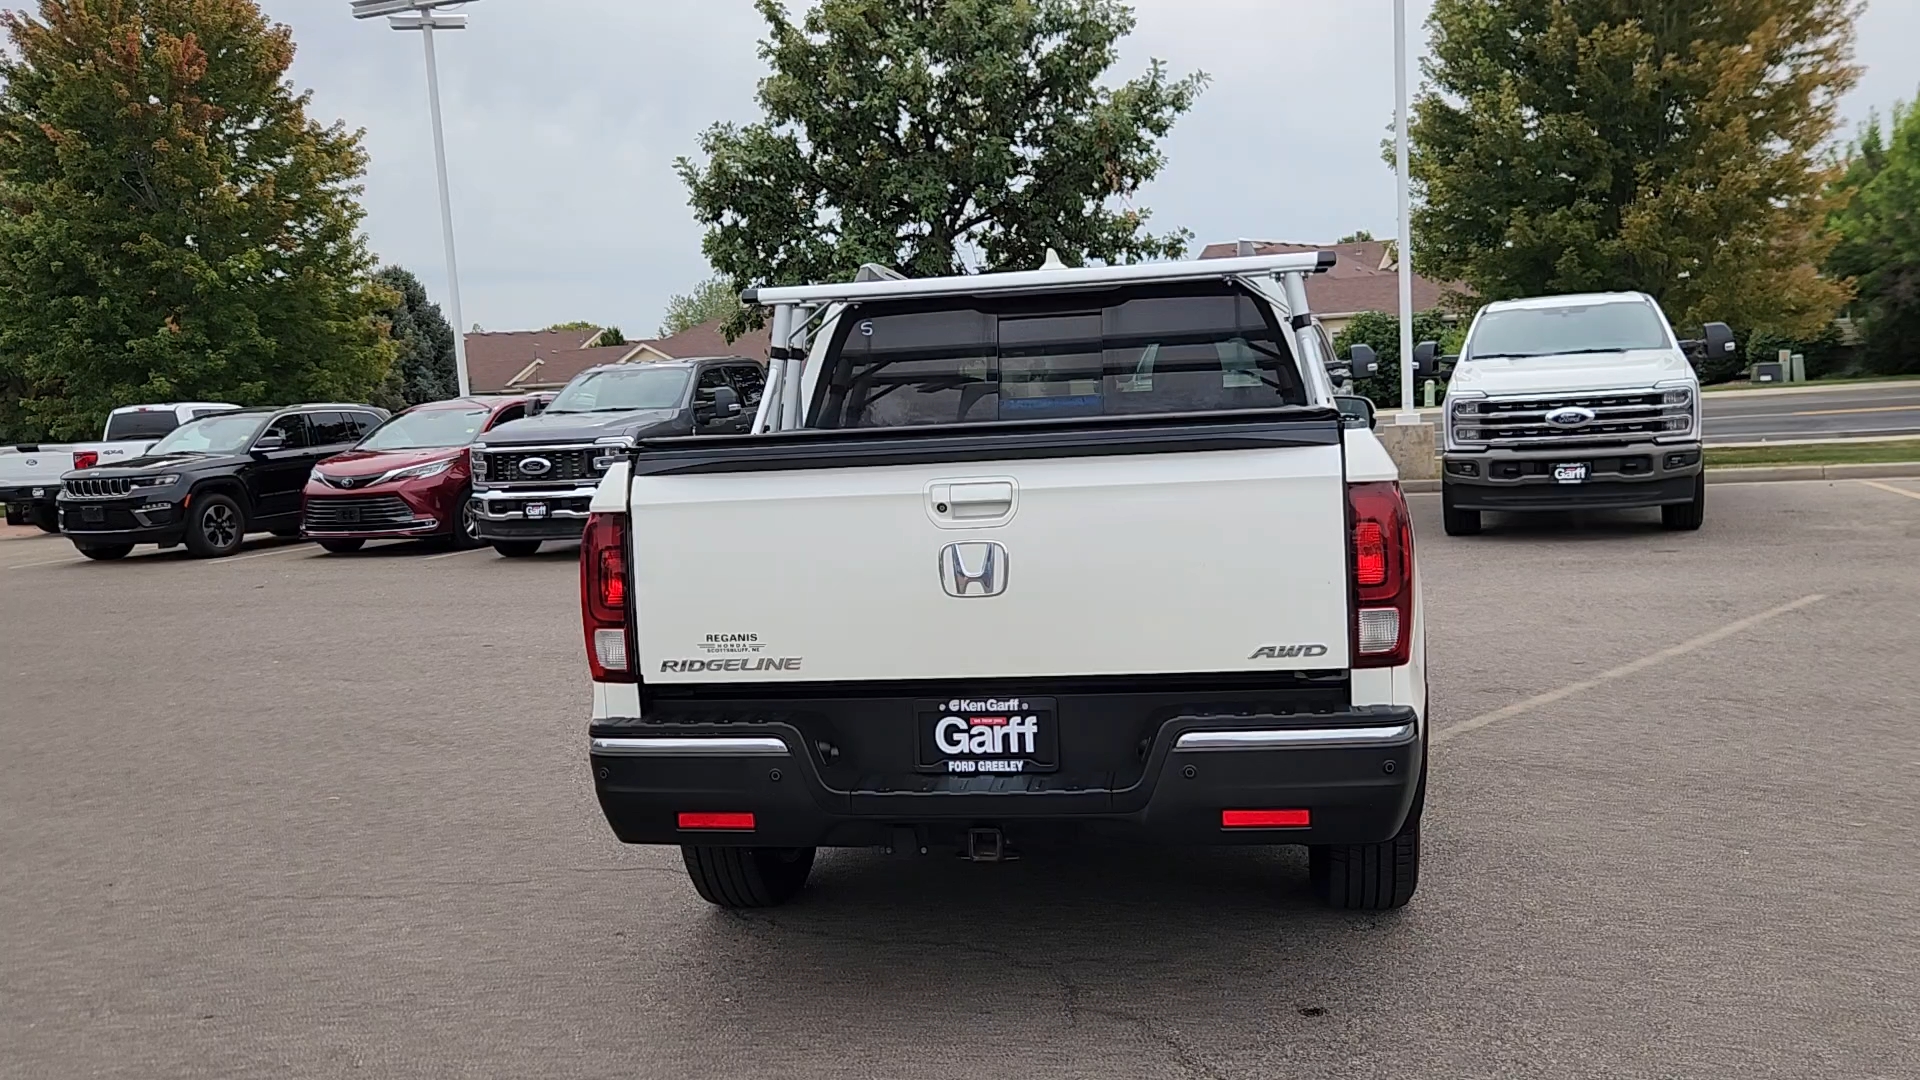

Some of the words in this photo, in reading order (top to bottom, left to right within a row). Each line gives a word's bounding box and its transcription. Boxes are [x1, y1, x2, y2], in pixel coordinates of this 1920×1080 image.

[1558, 411, 1581, 422] Ford
[1554, 466, 1586, 480] Garff
[525, 505, 546, 516] Garff
[706, 633, 758, 642] REGANIS
[1248, 644, 1328, 659] AWD
[660, 657, 803, 673] RIDGELINE
[935, 716, 1038, 754] Garff
[948, 761, 975, 772] FORD
[977, 760, 1024, 771] GREELEY
